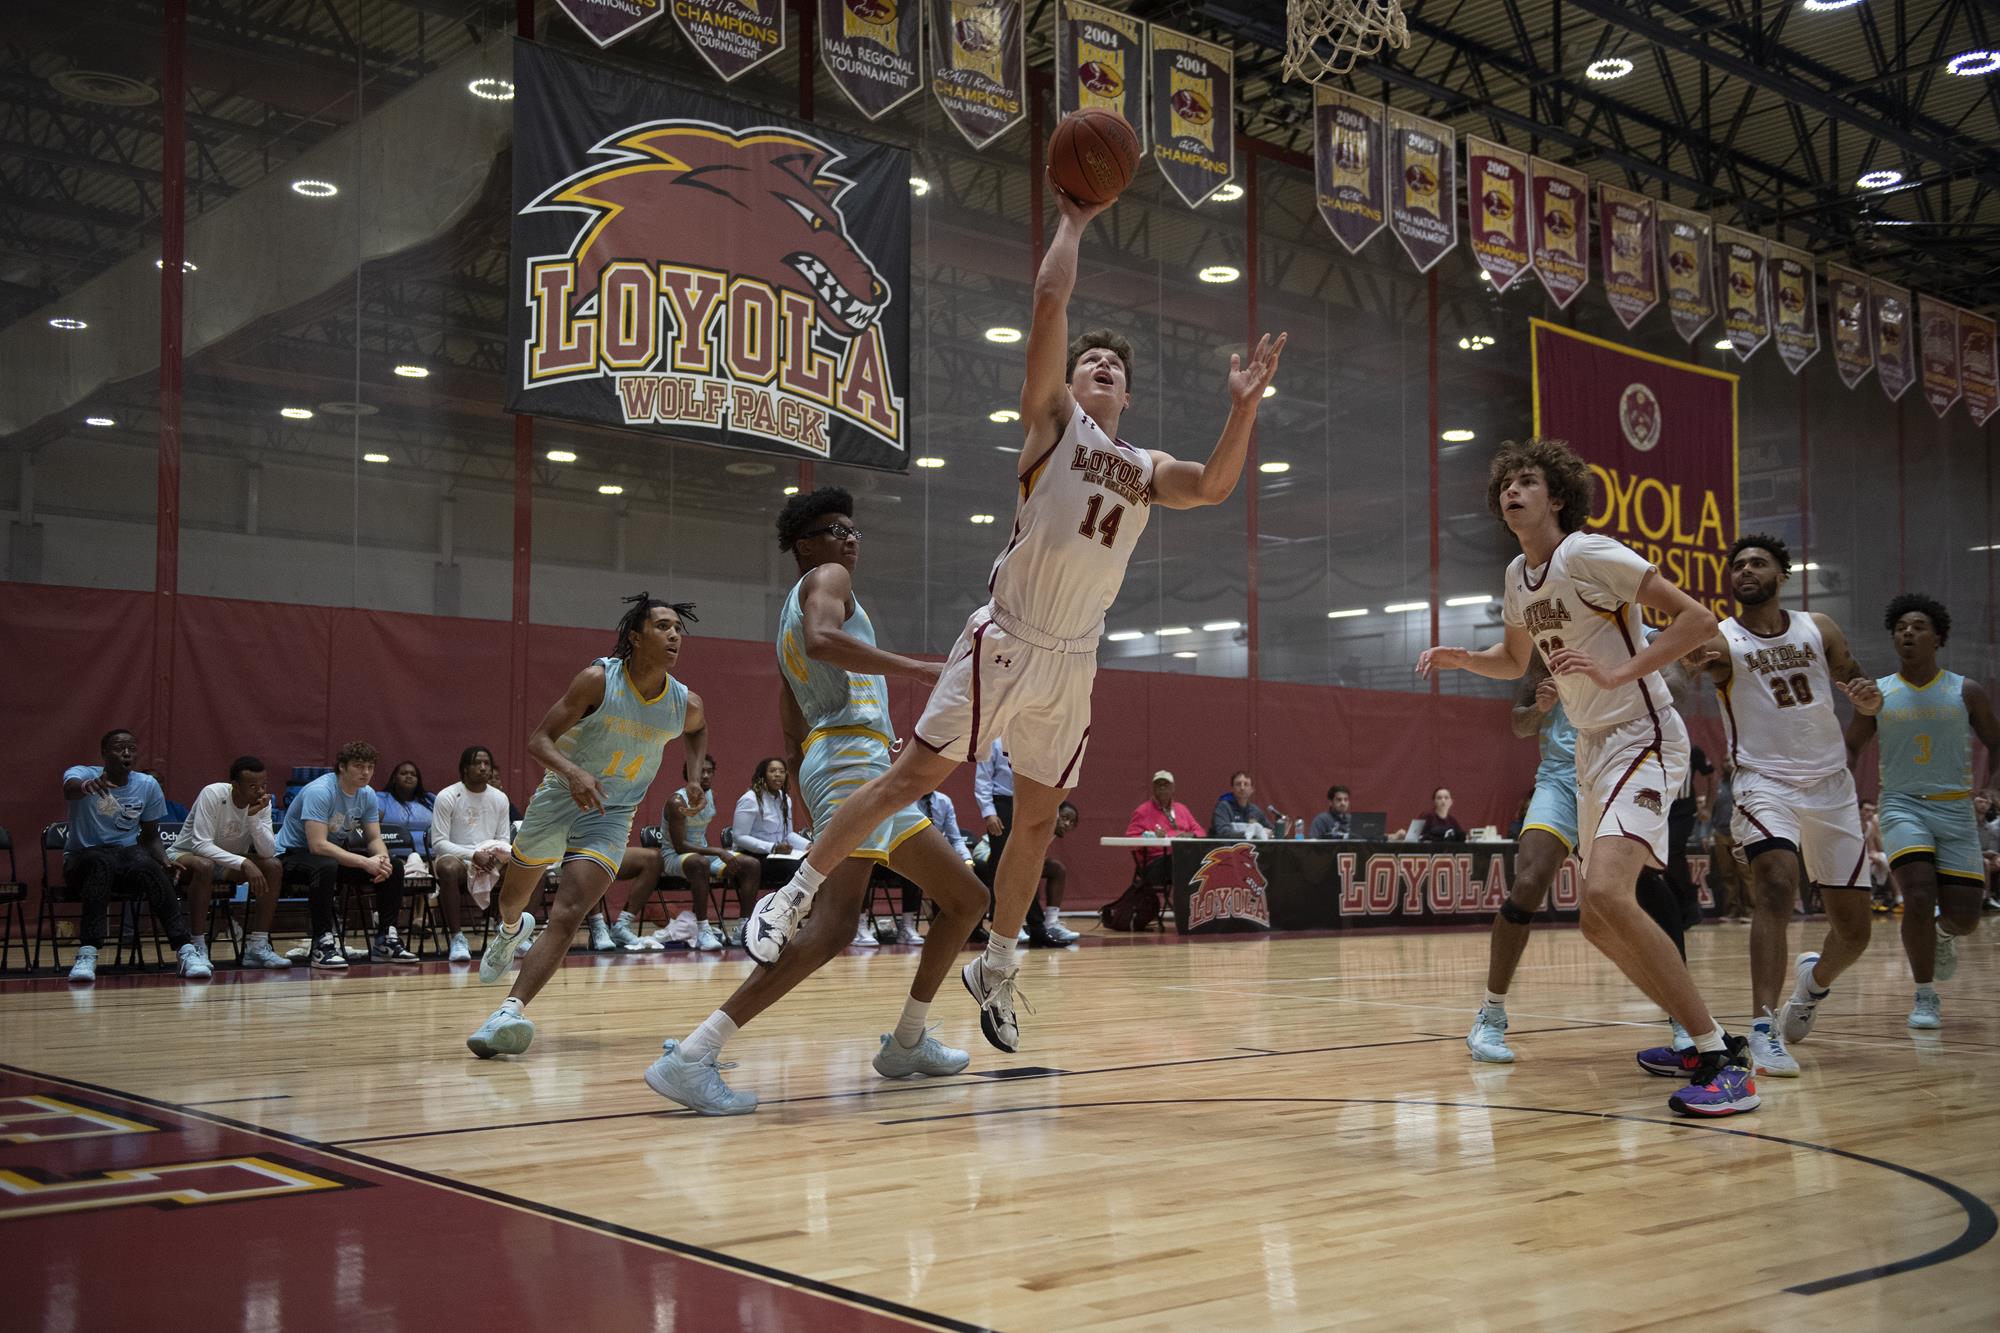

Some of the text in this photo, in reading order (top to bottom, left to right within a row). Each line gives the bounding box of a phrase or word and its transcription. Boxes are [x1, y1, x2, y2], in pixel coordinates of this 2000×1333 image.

[675, 2, 779, 45] CHAMPIONS
[723, 1, 762, 24] Region
[690, 22, 763, 52] NAIA NATIONAL
[694, 33, 759, 60] TOURNAMENT
[1084, 25, 1118, 48] 2004
[824, 38, 915, 75] NAIA REGIONAL
[830, 54, 909, 88] TOURNAMENT
[1176, 54, 1207, 76] 2004
[933, 79, 1020, 114] CHAMPIONS
[944, 97, 1008, 122] NAIA NATIONALS
[1154, 145, 1228, 175] CHAMPIONS
[1413, 213, 1450, 235] NATIONAL
[530, 261, 900, 442] LOYOLA
[619, 376, 829, 453] WOLF PACK
[1071, 444, 1152, 507] LOYOLA
[1078, 493, 1125, 549] 14
[1585, 463, 1728, 550] OYOLA
[1744, 642, 1817, 672] LOYOLA
[1770, 672, 1814, 709] 20
[1914, 732, 1932, 765] 3
[601, 751, 645, 782] 14
[1338, 853, 1511, 915] LOYOLA
[1189, 887, 1270, 929] LOYOLA
